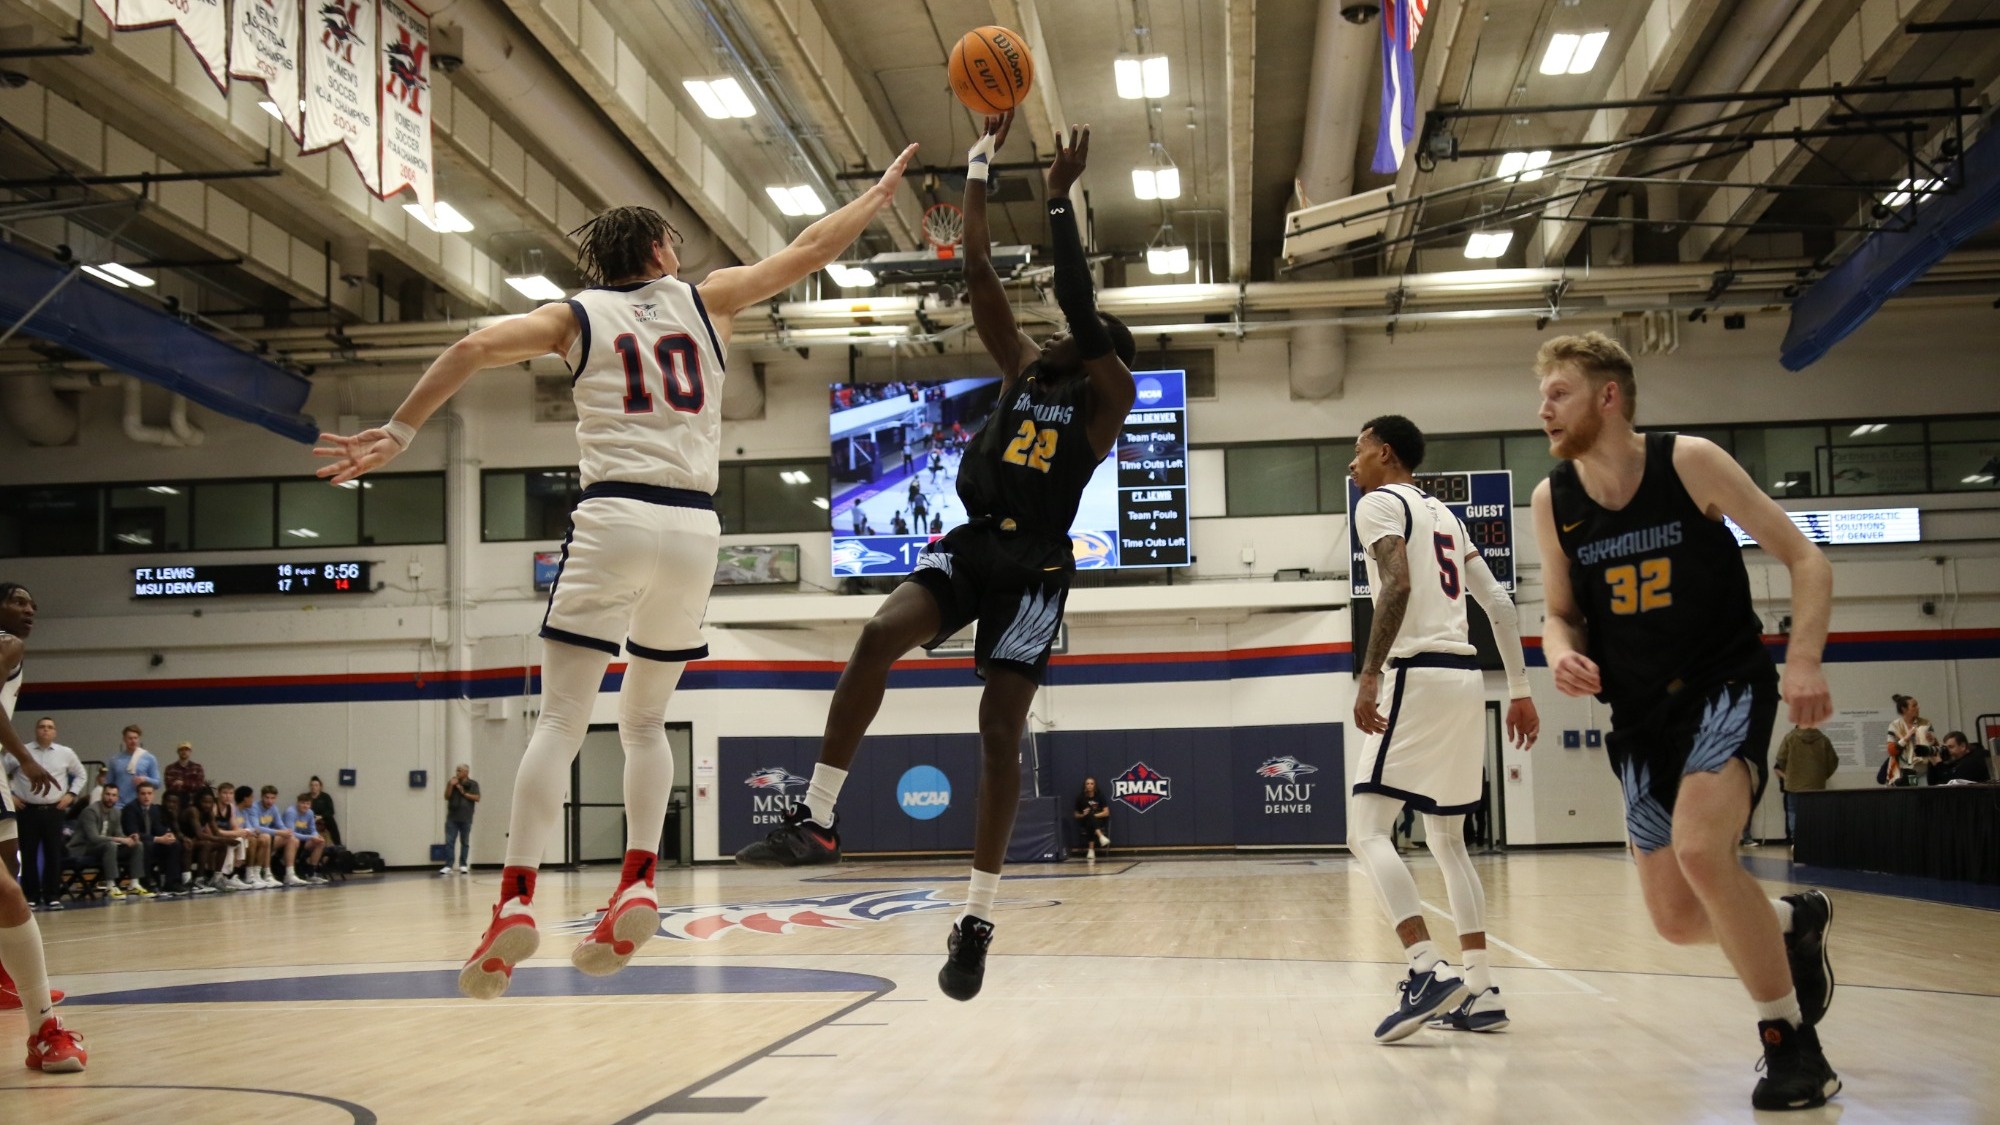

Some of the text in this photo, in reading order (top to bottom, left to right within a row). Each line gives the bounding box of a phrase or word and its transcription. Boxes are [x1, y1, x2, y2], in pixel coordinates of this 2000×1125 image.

[993, 33, 1024, 88] Wilson
[326, 54, 358, 88] WOMEN'S
[327, 75, 358, 104] SOCCER
[333, 113, 357, 135] 2004
[395, 126, 420, 153] SOCCER
[614, 333, 705, 415] 10
[1138, 389, 1163, 399] NCAA
[1143, 412, 1177, 424] DENVER
[1126, 432, 1176, 442] Team Fouls
[1002, 420, 1059, 474] 22
[1147, 444, 1155, 453] 4
[1120, 459, 1184, 470] Time Outs Left
[1148, 471, 1155, 480] 4
[1131, 490, 1173, 502] FT. LEWIS
[1127, 510, 1178, 520] Team Fouls
[1466, 505, 1504, 518] GUEST
[1835, 512, 1900, 521] CHIROPRACTIC
[1149, 521, 1157, 531] 4
[1835, 522, 1885, 531] SOLUTIONS
[1847, 531, 1884, 540] DENVER
[1122, 537, 1186, 548] Time Outs Left
[1577, 521, 1683, 566] SKYHAWKS
[1150, 549, 1158, 559] 4
[1484, 548, 1511, 557] FOULS
[277, 565, 292, 576] 16
[324, 564, 359, 579] 8:56
[1433, 531, 1461, 601] 5
[135, 567, 195, 581] FT. LEWIS
[295, 568, 316, 576] Period
[277, 579, 292, 591] 17
[303, 577, 309, 587] 1
[335, 579, 350, 590] 14
[1605, 557, 1672, 615] 32
[135, 582, 214, 595] MSU DENVER
[1354, 585, 1371, 595] SCO
[1115, 780, 1168, 797] RMAC
[1264, 784, 1312, 801] MSU
[902, 791, 950, 807] NCAA
[1264, 804, 1312, 814] DENVER
[752, 815, 785, 824] DENV
